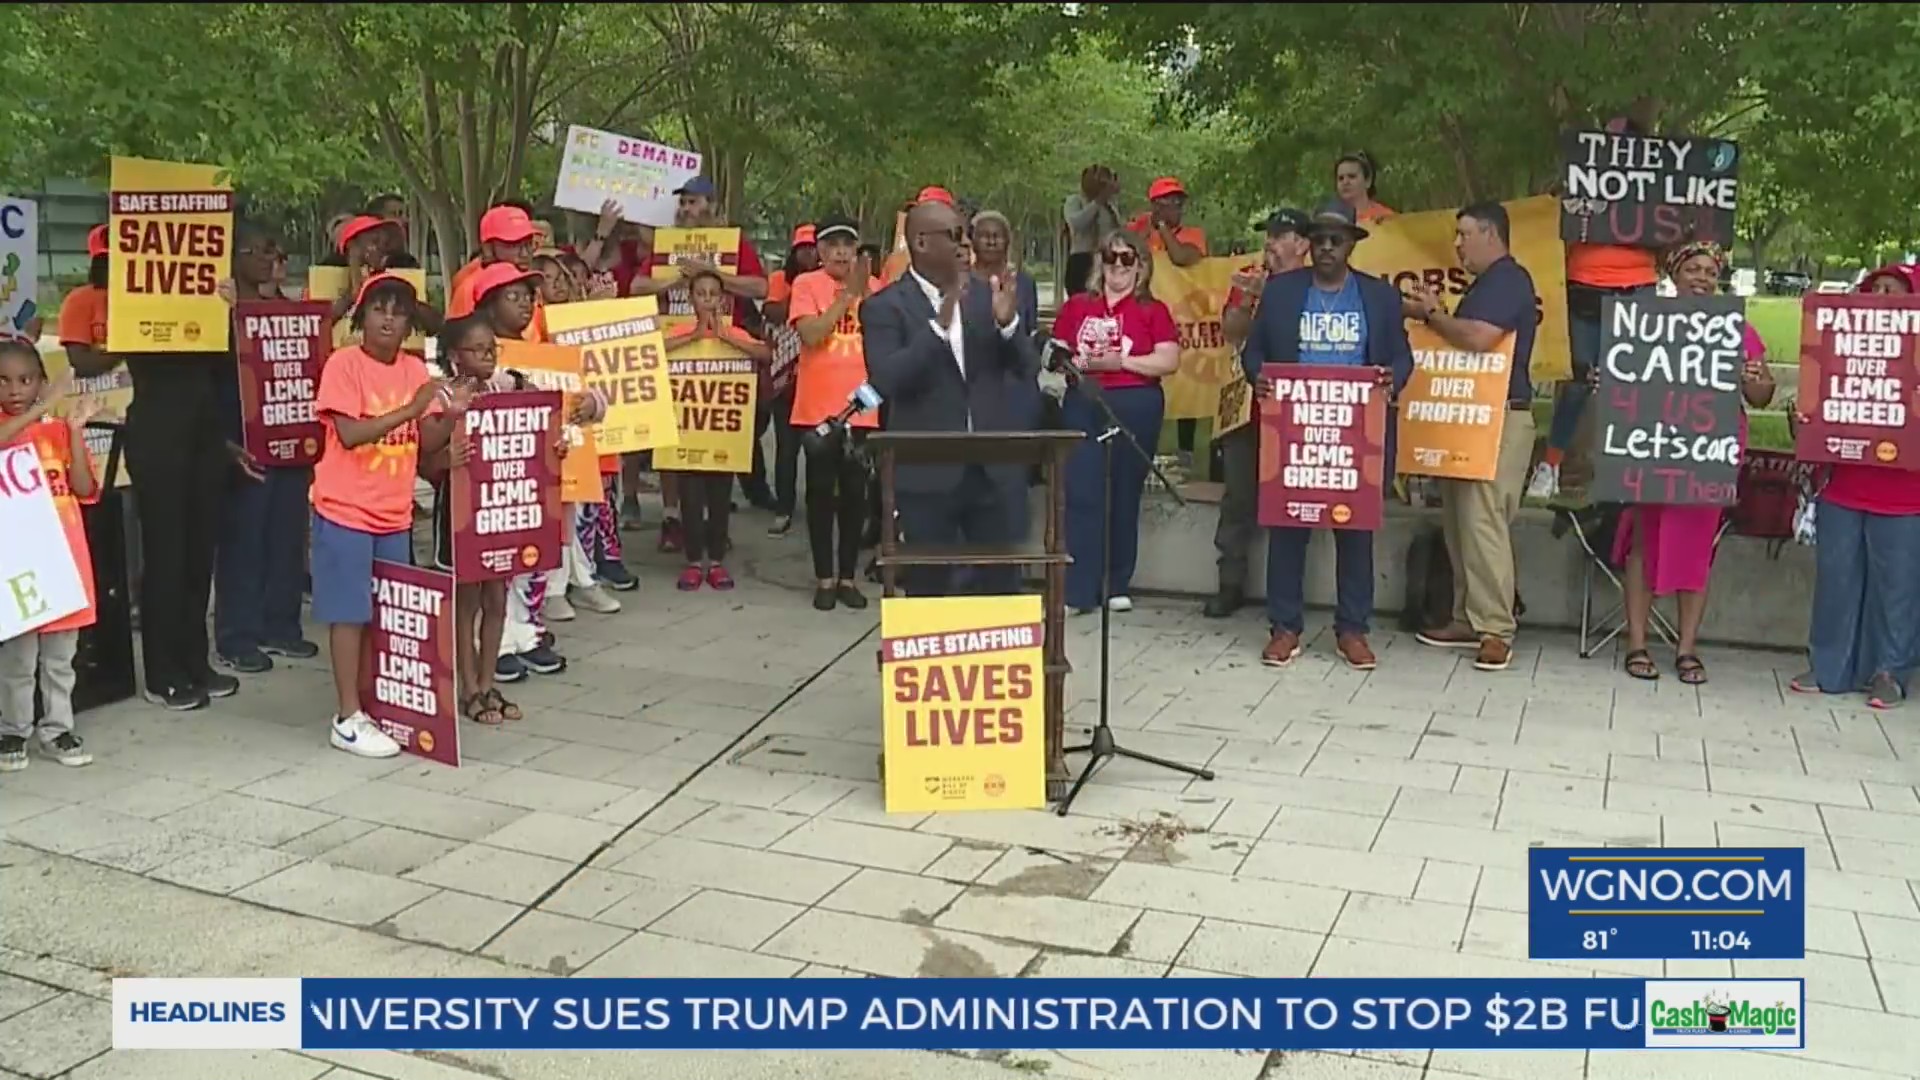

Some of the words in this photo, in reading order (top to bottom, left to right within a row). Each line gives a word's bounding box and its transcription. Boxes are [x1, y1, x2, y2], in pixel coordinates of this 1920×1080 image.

[618, 140, 697, 170] DEMAND
[1578, 132, 1692, 171] THEY
[1568, 164, 1656, 202] NOT
[1665, 175, 1738, 210] LIKE
[119, 195, 158, 212] SAFE
[160, 194, 228, 211] STAFFING
[119, 219, 225, 258] SAVES
[126, 260, 217, 296] LIVES
[245, 315, 321, 338] PATIENT
[556, 327, 592, 346] SAFE
[592, 317, 656, 341] STAFFING
[1613, 301, 1743, 349] Nurses
[1816, 307, 1920, 335] PATIENT
[262, 339, 310, 361] NEED
[1834, 333, 1902, 358] NEED
[273, 362, 302, 379] OVER
[584, 344, 660, 376] AVES
[669, 361, 694, 374] AFE
[695, 359, 752, 373] STAFFING
[1413, 349, 1506, 374] PATIENTS
[1606, 343, 1738, 391] CARE
[1845, 358, 1888, 376] OVER
[264, 379, 314, 403] LCMC
[1275, 378, 1373, 405] PATIENT
[1430, 378, 1475, 399] OVER
[1830, 376, 1902, 401] LCMC
[1293, 403, 1353, 427] NEED
[1406, 402, 1493, 425] PROFITS
[1610, 385, 1639, 422] 4
[1823, 400, 1906, 427] GREED
[465, 406, 552, 435] PATIENT
[678, 407, 742, 432] IVES
[482, 434, 536, 461] NEED
[1304, 426, 1341, 444] OVER
[1290, 443, 1354, 468] LCMC
[1691, 435, 1740, 465] care
[492, 461, 526, 480] OVER
[1284, 467, 1358, 491] GREED
[480, 479, 538, 508] LCMC
[1622, 466, 1643, 501] 4
[1652, 467, 1738, 505] Them
[476, 504, 543, 535] GREED
[6, 570, 47, 621] E
[380, 605, 428, 640] NEED
[389, 634, 420, 659] OVER
[892, 637, 941, 659] SAFE
[944, 626, 1033, 655] STAFFING
[379, 651, 432, 688] LCMC
[894, 663, 1033, 704] SAVES
[375, 678, 437, 716] GREED
[905, 707, 1024, 747] LIVES
